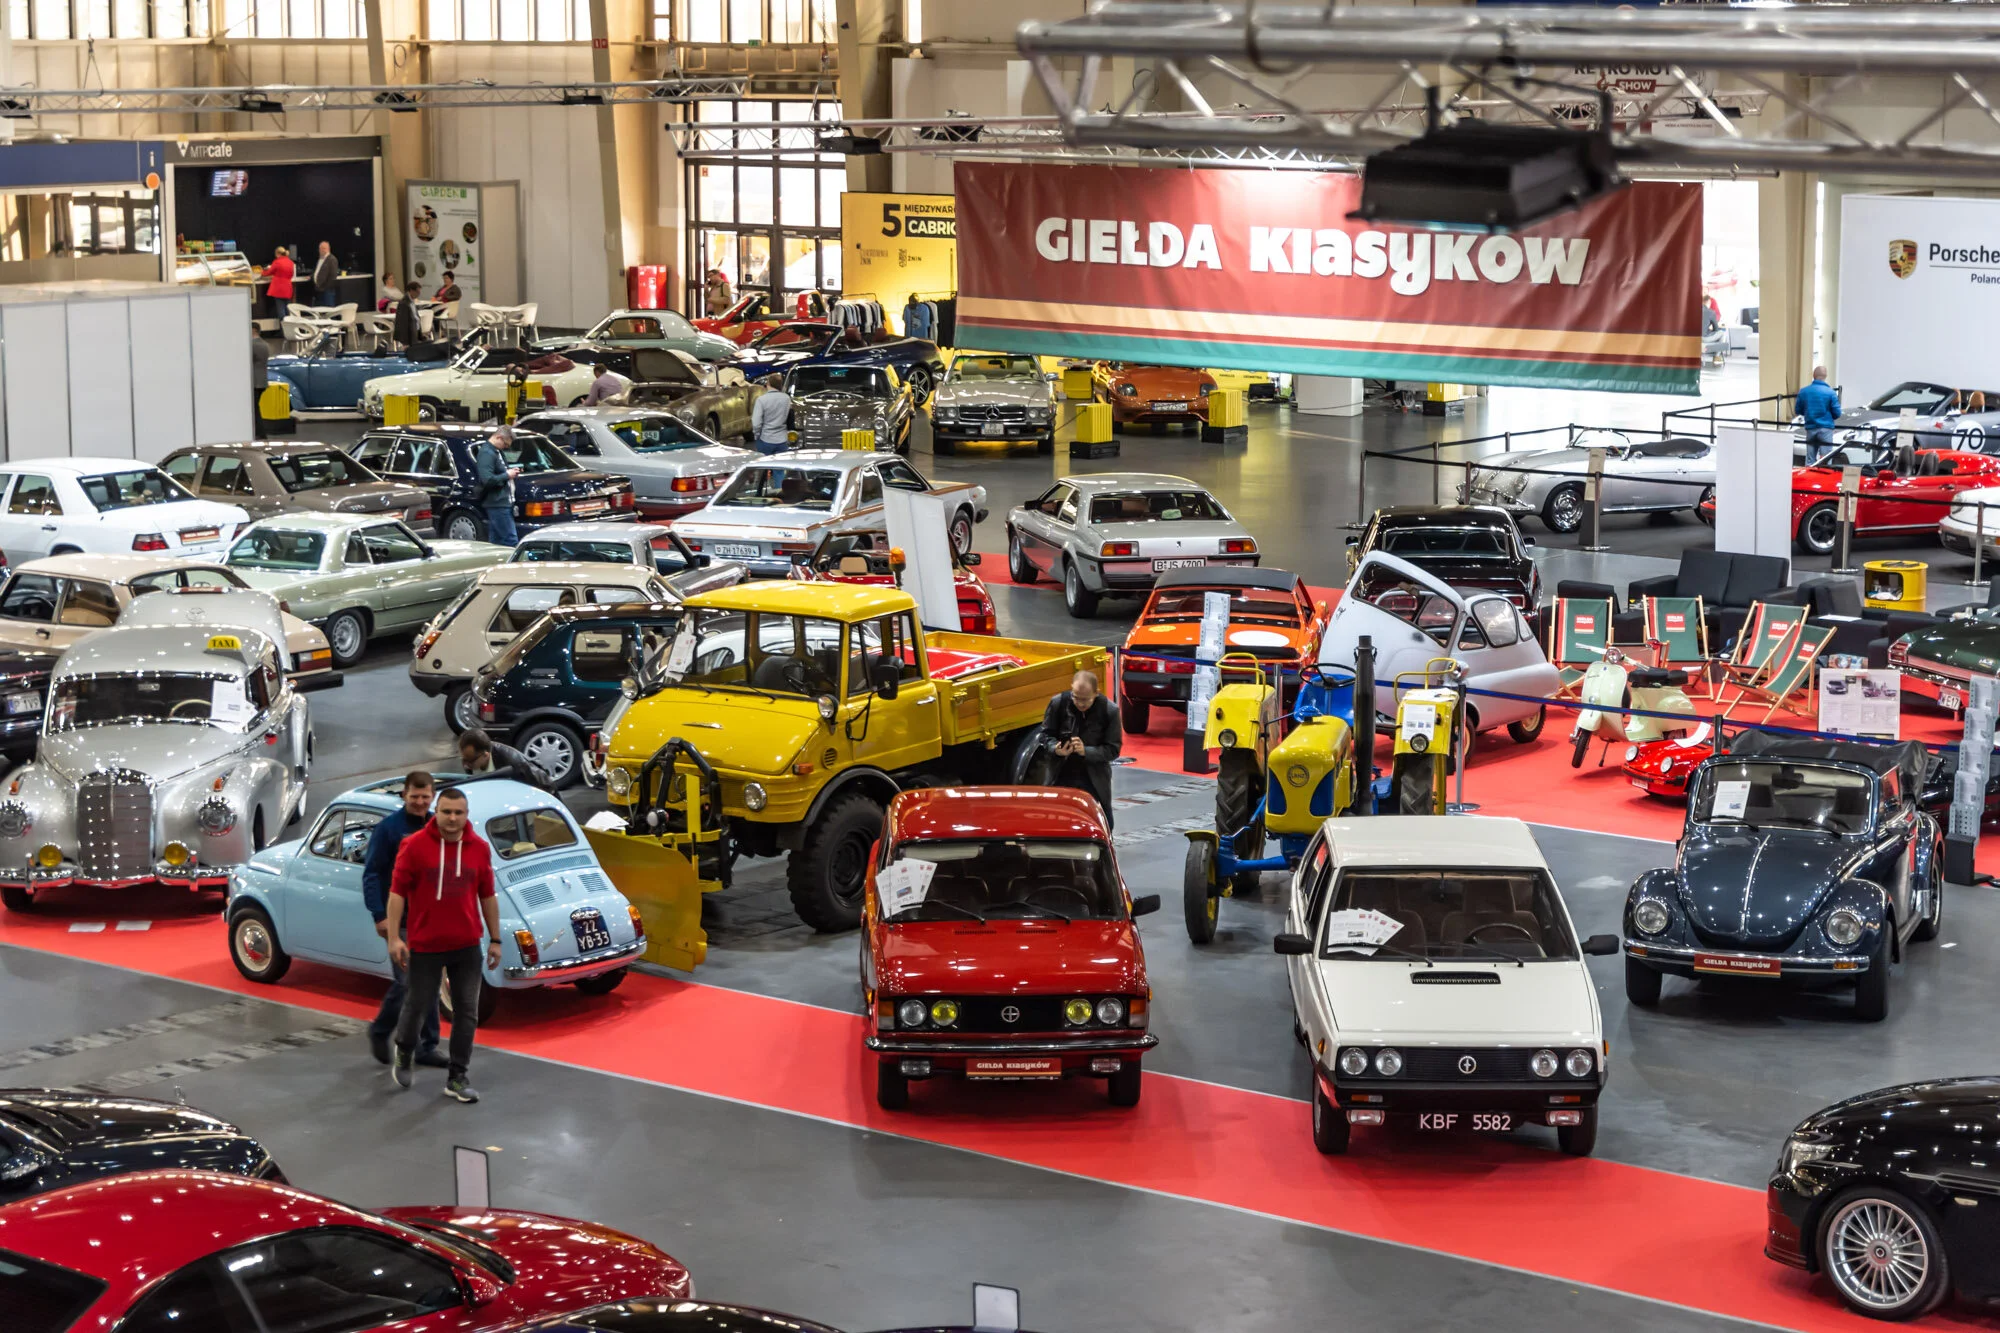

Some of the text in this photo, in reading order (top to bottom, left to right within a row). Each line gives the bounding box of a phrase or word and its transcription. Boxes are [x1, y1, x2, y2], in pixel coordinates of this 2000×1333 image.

[1619, 81, 1652, 91] SHOW
[904, 204, 956, 214] MIĘDZYNAR
[882, 203, 902, 237] 5
[1035, 216, 1223, 270] GIEŁDA
[1929, 243, 2000, 263] Porsche
[1956, 428, 1983, 451] 70
[211, 640, 235, 648] TAXI
[583, 920, 598, 934] 22
[578, 931, 609, 950] YB-33
[1420, 1113, 1511, 1131] KBF 5582
